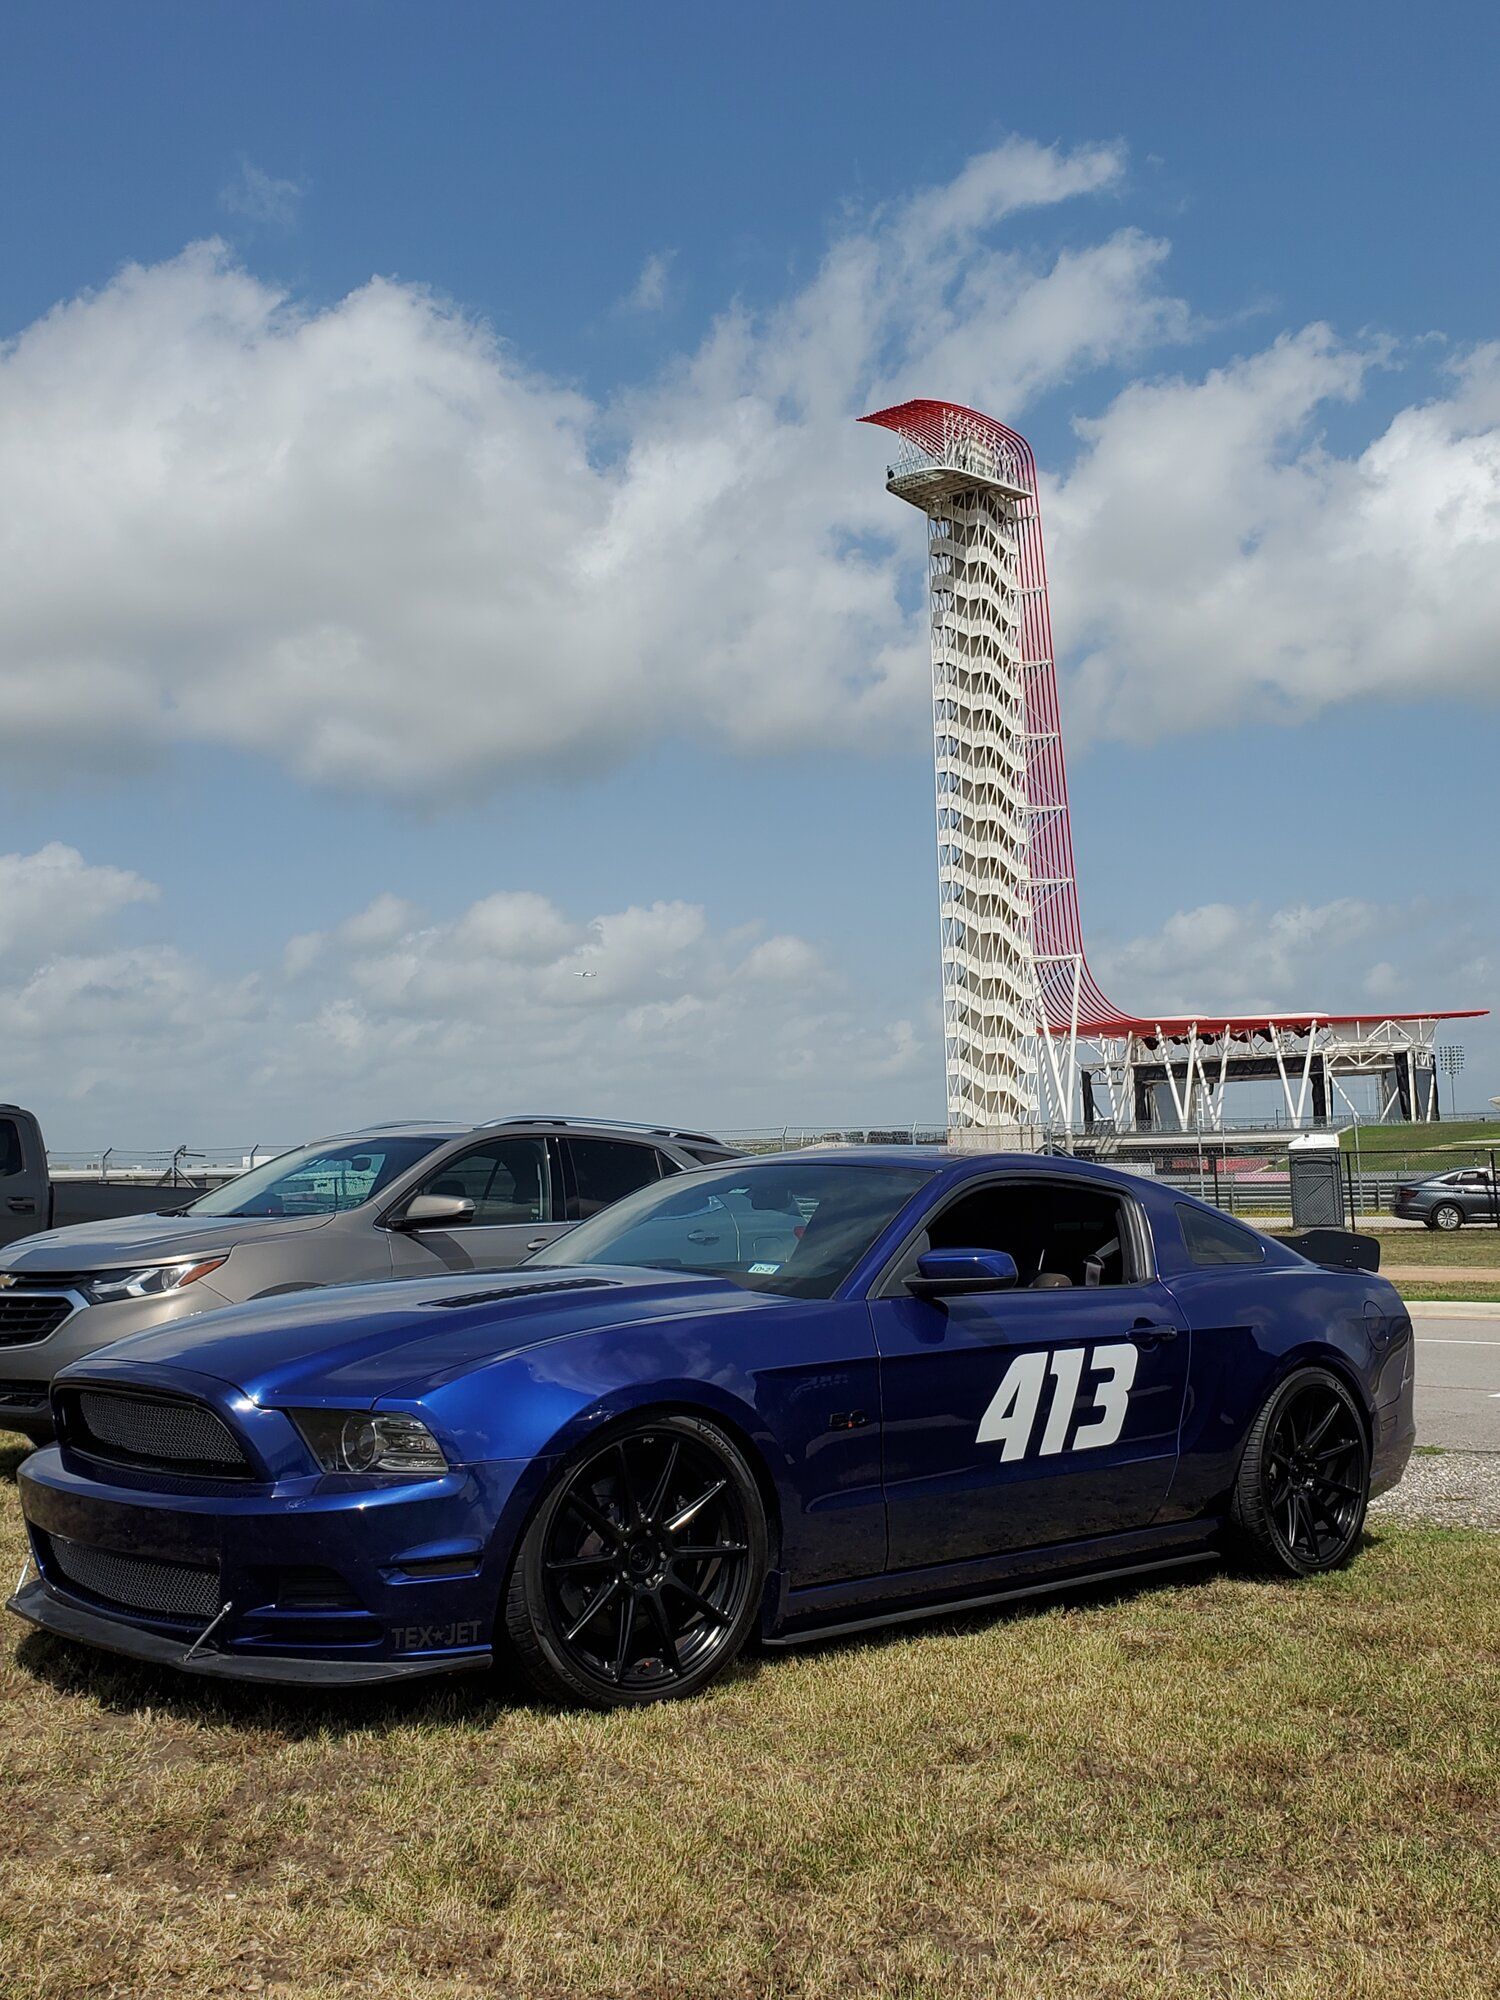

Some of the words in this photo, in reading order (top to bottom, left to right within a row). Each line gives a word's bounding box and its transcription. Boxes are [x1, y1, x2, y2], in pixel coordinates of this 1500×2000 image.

[975, 1343, 1138, 1463] 413
[391, 1626, 433, 1649] TEX
[445, 1620, 482, 1645] JET
